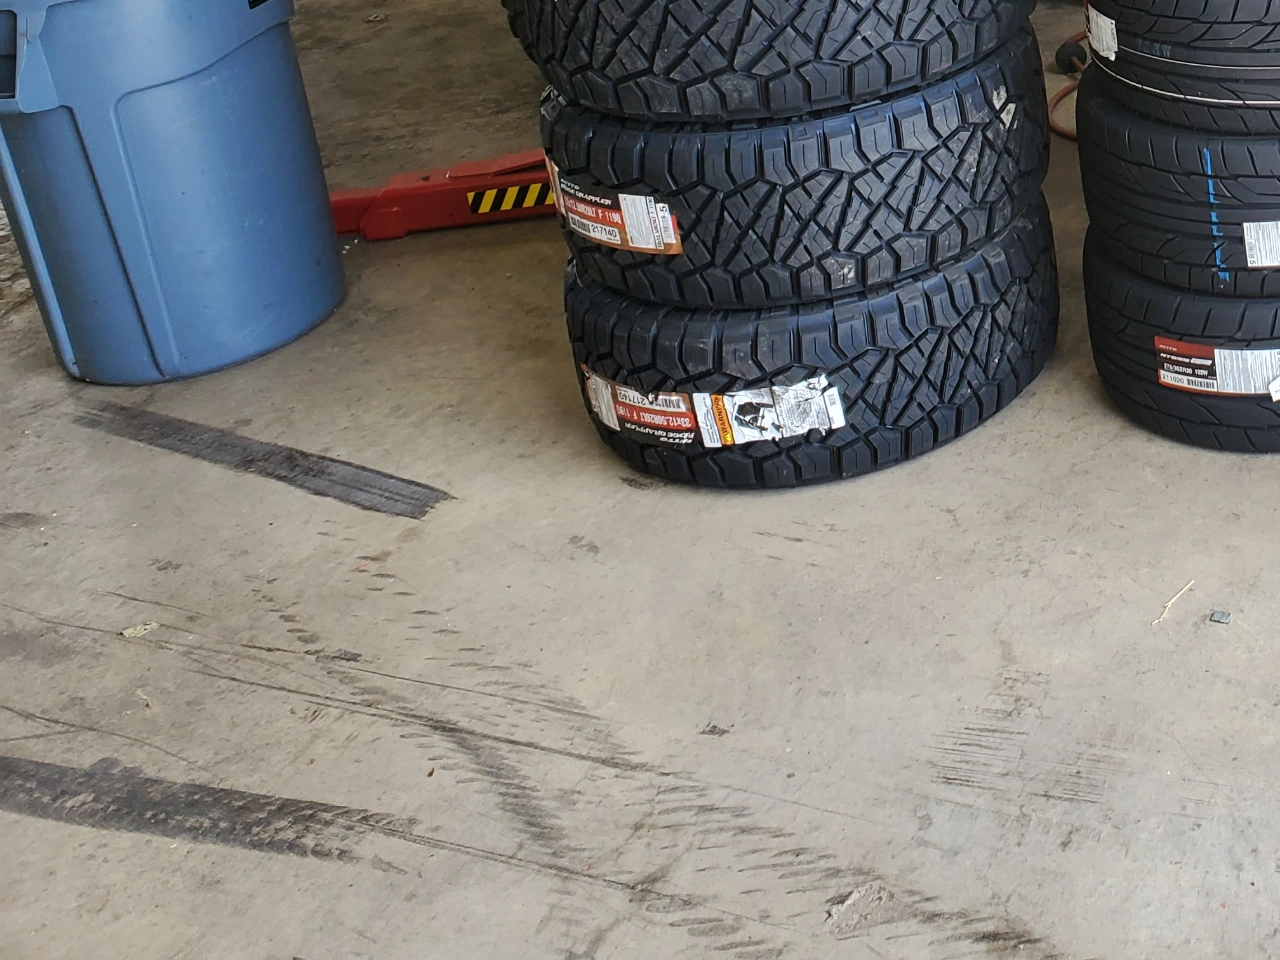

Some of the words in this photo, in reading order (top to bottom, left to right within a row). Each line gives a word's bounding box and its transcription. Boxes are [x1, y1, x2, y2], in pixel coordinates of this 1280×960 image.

[575, 190, 612, 206] GRAPPLER
[660, 205, 667, 213] 5
[598, 209, 603, 219] F
[605, 211, 622, 224] 119Q
[591, 224, 617, 238] 217140
[1162, 373, 1185, 384] 211020
[619, 391, 646, 405] 217140
[616, 404, 631, 417] 119Q
[625, 422, 667, 437] GRAPPLER
[667, 431, 694, 439] RIDGE
